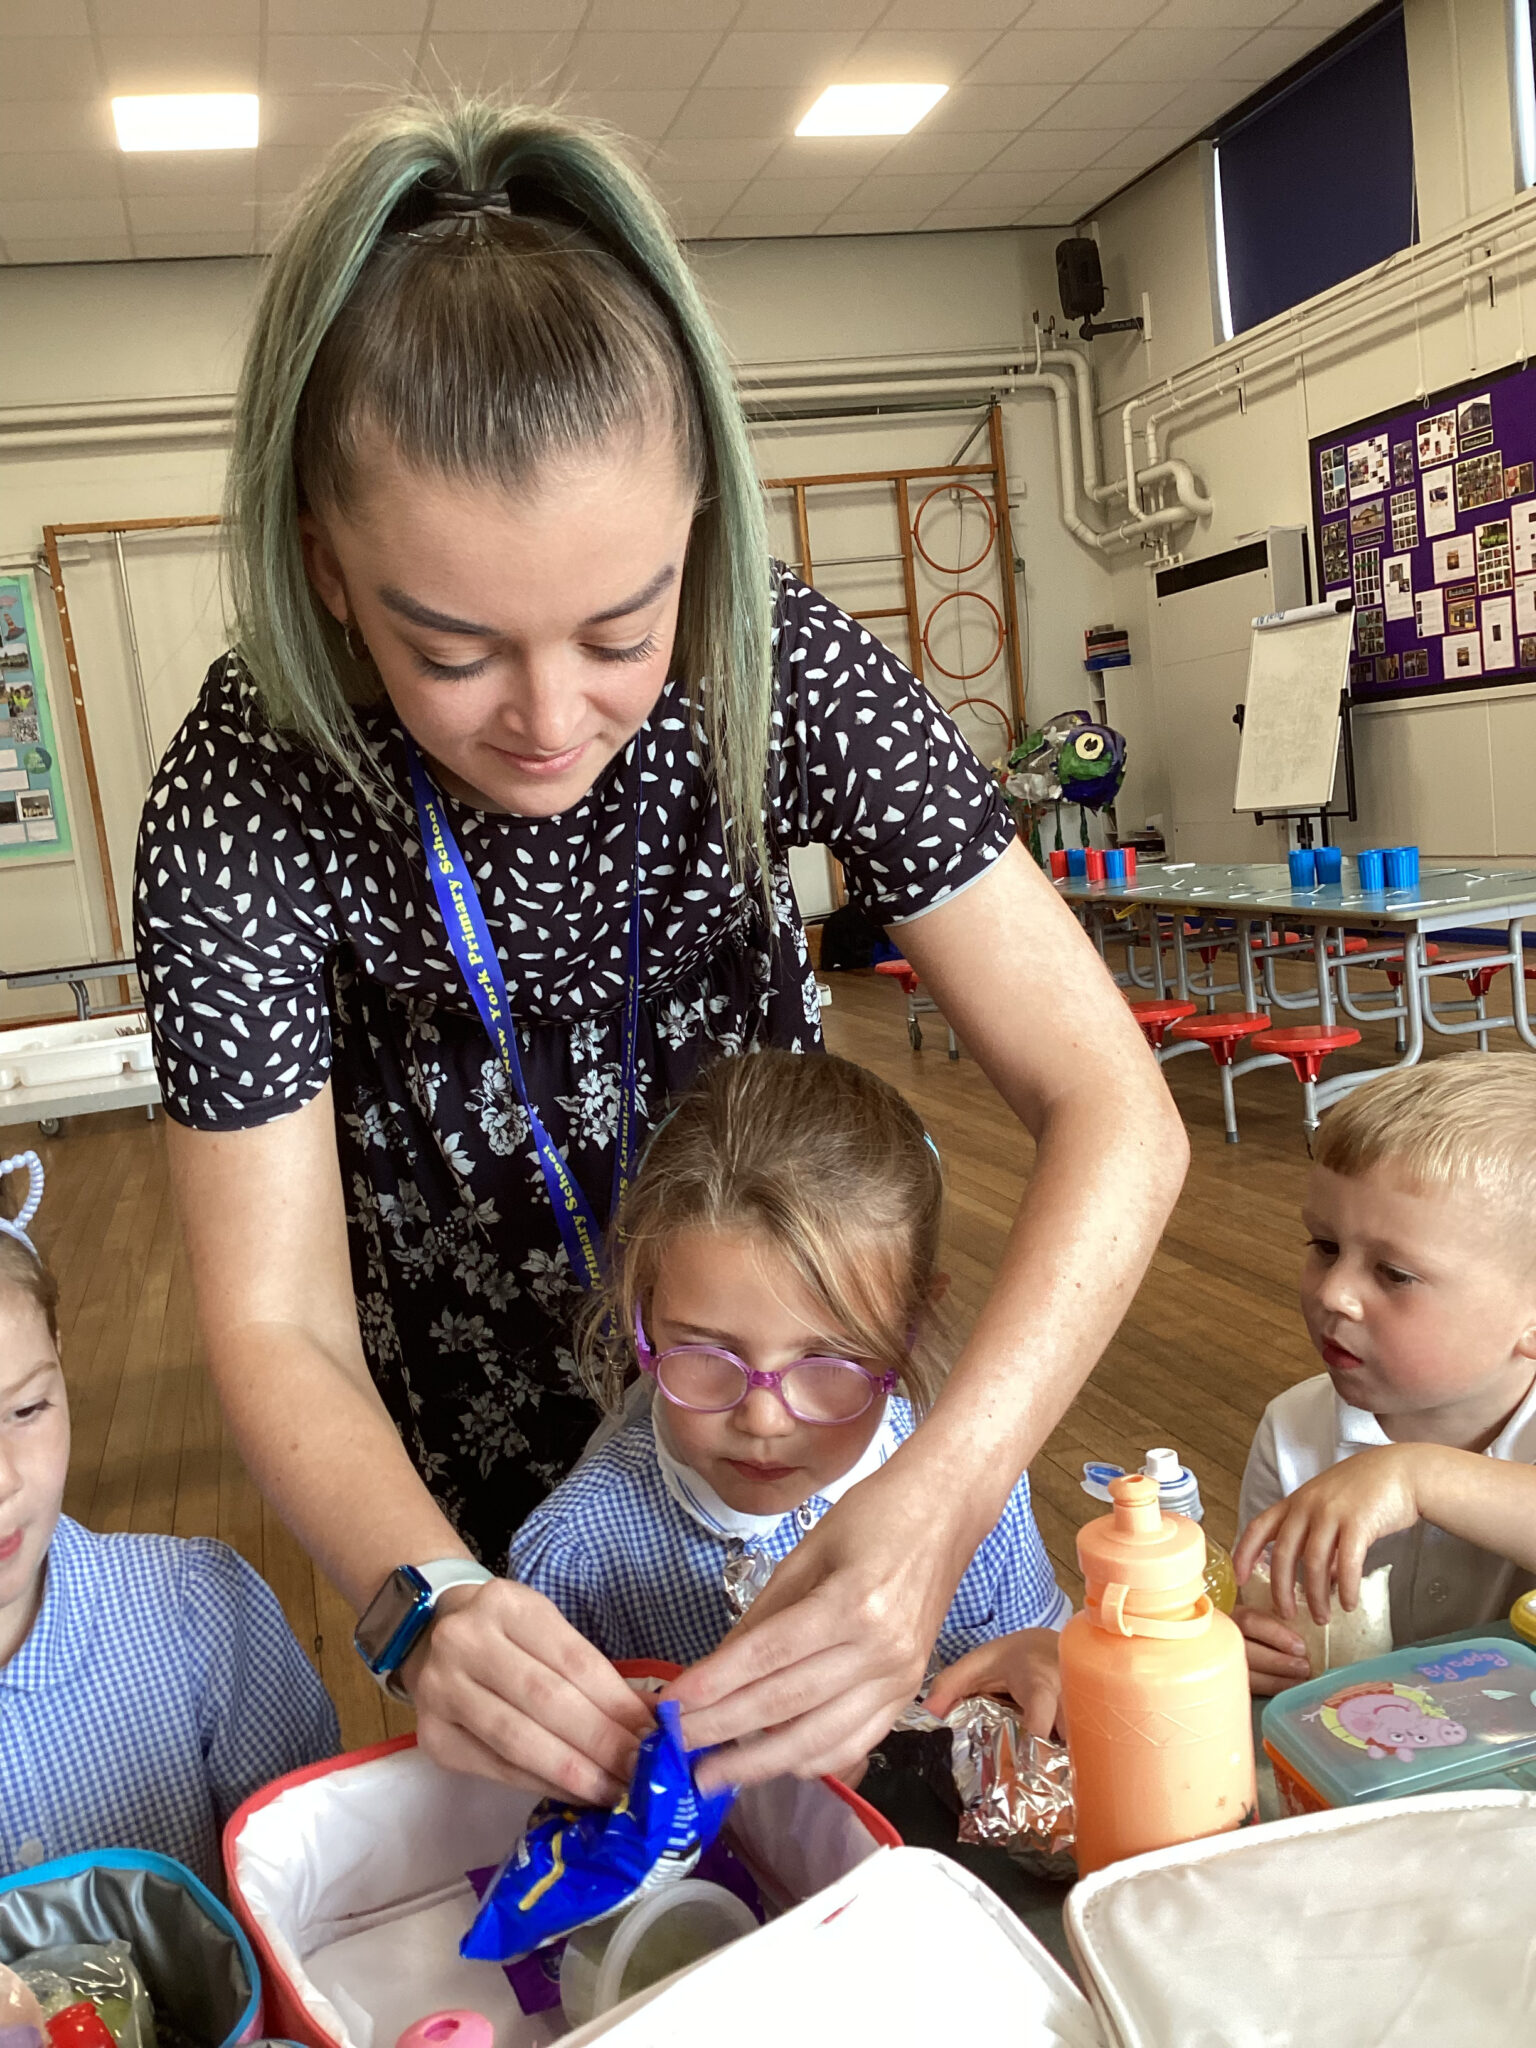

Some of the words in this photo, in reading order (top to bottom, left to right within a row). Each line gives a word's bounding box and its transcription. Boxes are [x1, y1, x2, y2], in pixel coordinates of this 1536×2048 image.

[425, 802, 455, 874] School
[448, 878, 483, 965] Primary
[477, 969, 502, 1022] York
[497, 1028, 513, 1074] New
[619, 1087, 630, 1172] Primary
[543, 1144, 578, 1211] School
[572, 1215, 604, 1290] Primary
[1447, 1652, 1509, 1667] Peppa
